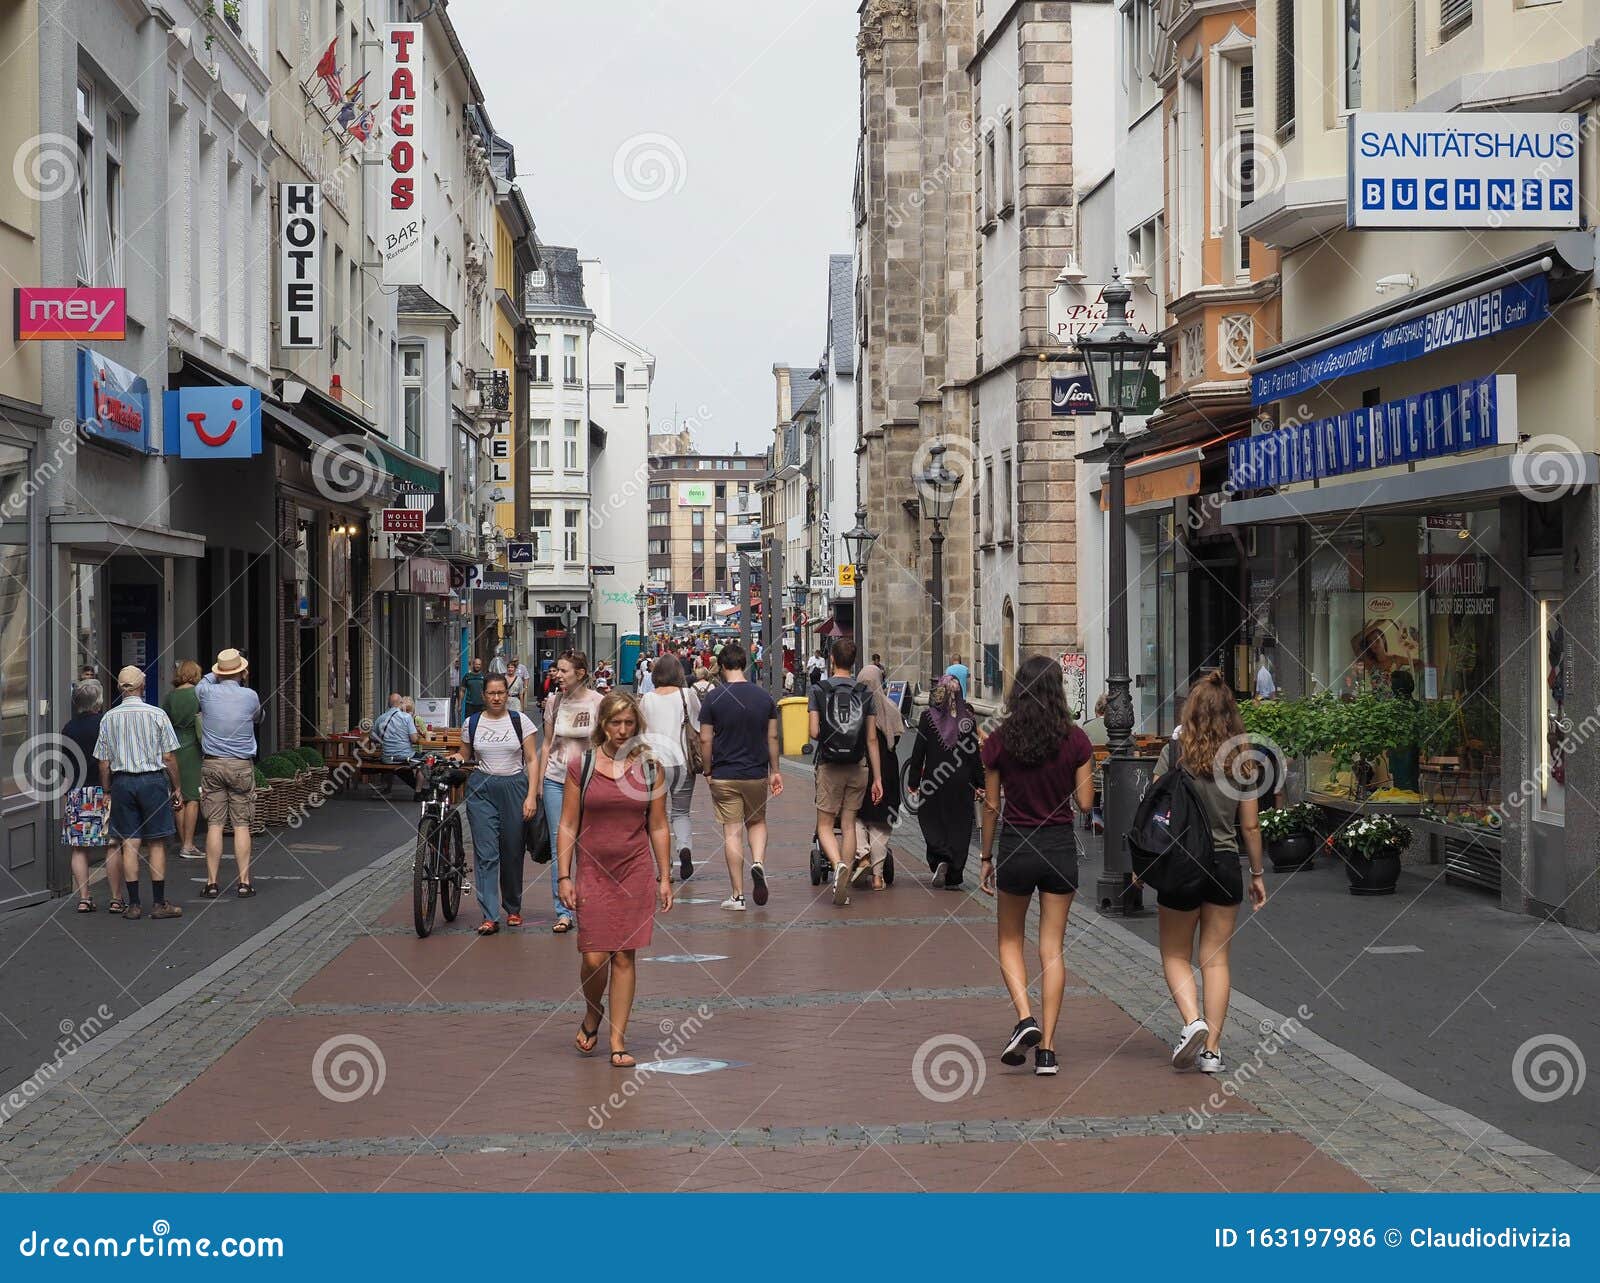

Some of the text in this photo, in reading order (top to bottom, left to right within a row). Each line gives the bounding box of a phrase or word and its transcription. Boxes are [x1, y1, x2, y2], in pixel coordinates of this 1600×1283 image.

[389, 31, 416, 210] TACOS
[1361, 128, 1574, 159] SANITÄTSHAUS
[1364, 181, 1572, 207] BÜCHNER
[386, 222, 418, 250] BAR
[286, 186, 316, 344] HOTEL
[30, 300, 115, 332] mey
[1258, 377, 1271, 397] Der
[1272, 369, 1299, 393] Partner
[1323, 342, 1376, 374] Gesundheit
[1424, 289, 1502, 352] BÜCHNER
[1505, 299, 1527, 324] GmbH
[1052, 383, 1094, 407] Sion
[1121, 384, 1147, 399] JEVR
[821, 512, 830, 573] ANTIK
